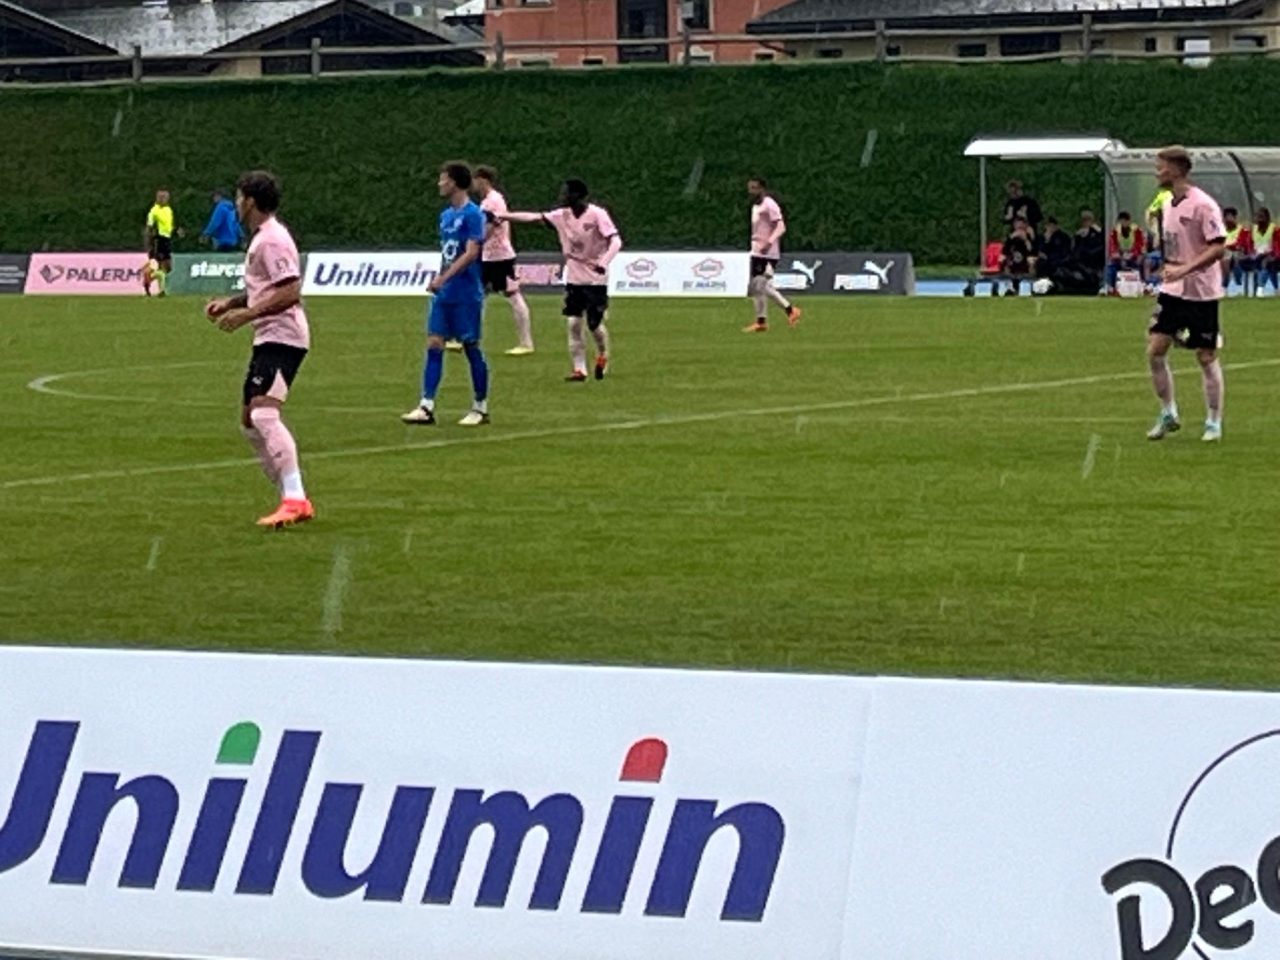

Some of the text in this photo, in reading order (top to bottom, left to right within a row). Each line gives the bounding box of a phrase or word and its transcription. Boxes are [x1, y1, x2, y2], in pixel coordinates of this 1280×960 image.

[65, 268, 143, 283] PALERM
[190, 260, 246, 278] starca
[313, 262, 438, 287] Unilumin
[1100, 833, 1280, 960] De
